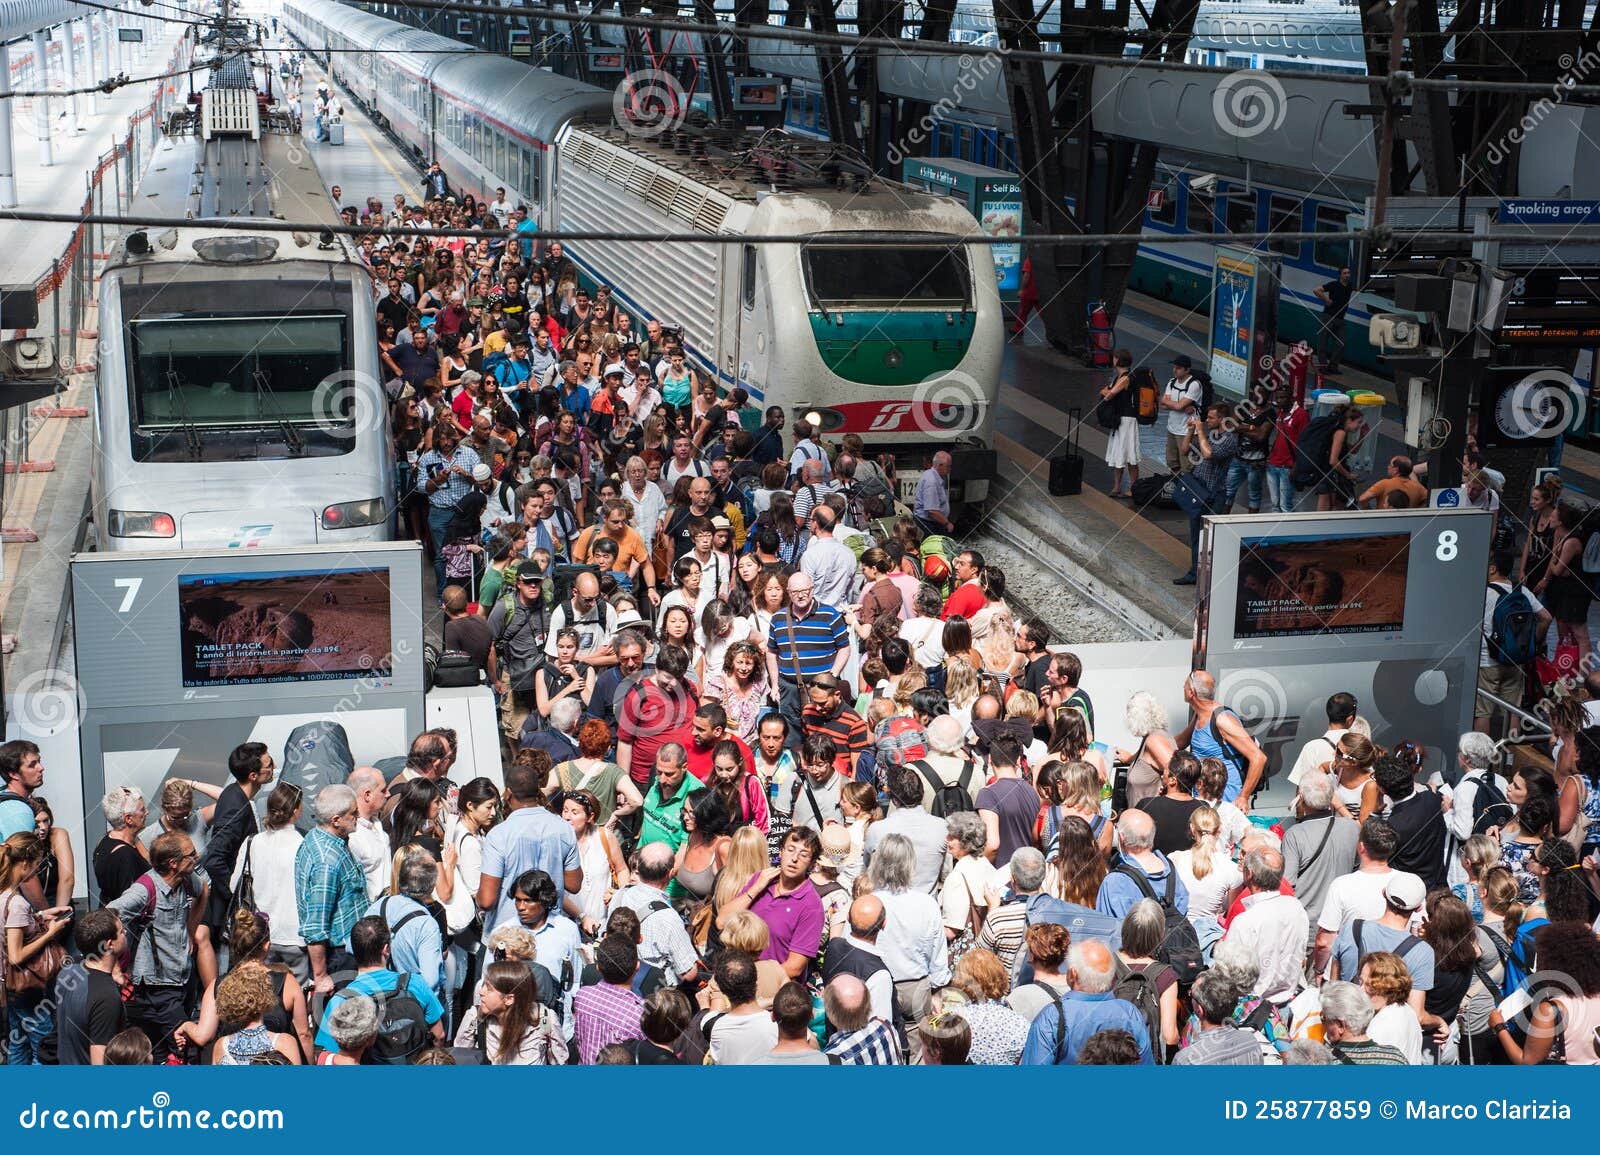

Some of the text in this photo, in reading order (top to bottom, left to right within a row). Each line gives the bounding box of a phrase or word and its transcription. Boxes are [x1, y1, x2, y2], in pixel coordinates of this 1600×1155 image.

[992, 184, 1021, 193] Self Ba
[1507, 202, 1591, 217] Smoking area
[1513, 277, 1526, 296] 8
[903, 482, 918, 496] 12
[1436, 530, 1458, 561] 8
[114, 577, 143, 612] 7
[195, 642, 262, 652] TABLET PACK
[280, 648, 309, 656] partire
